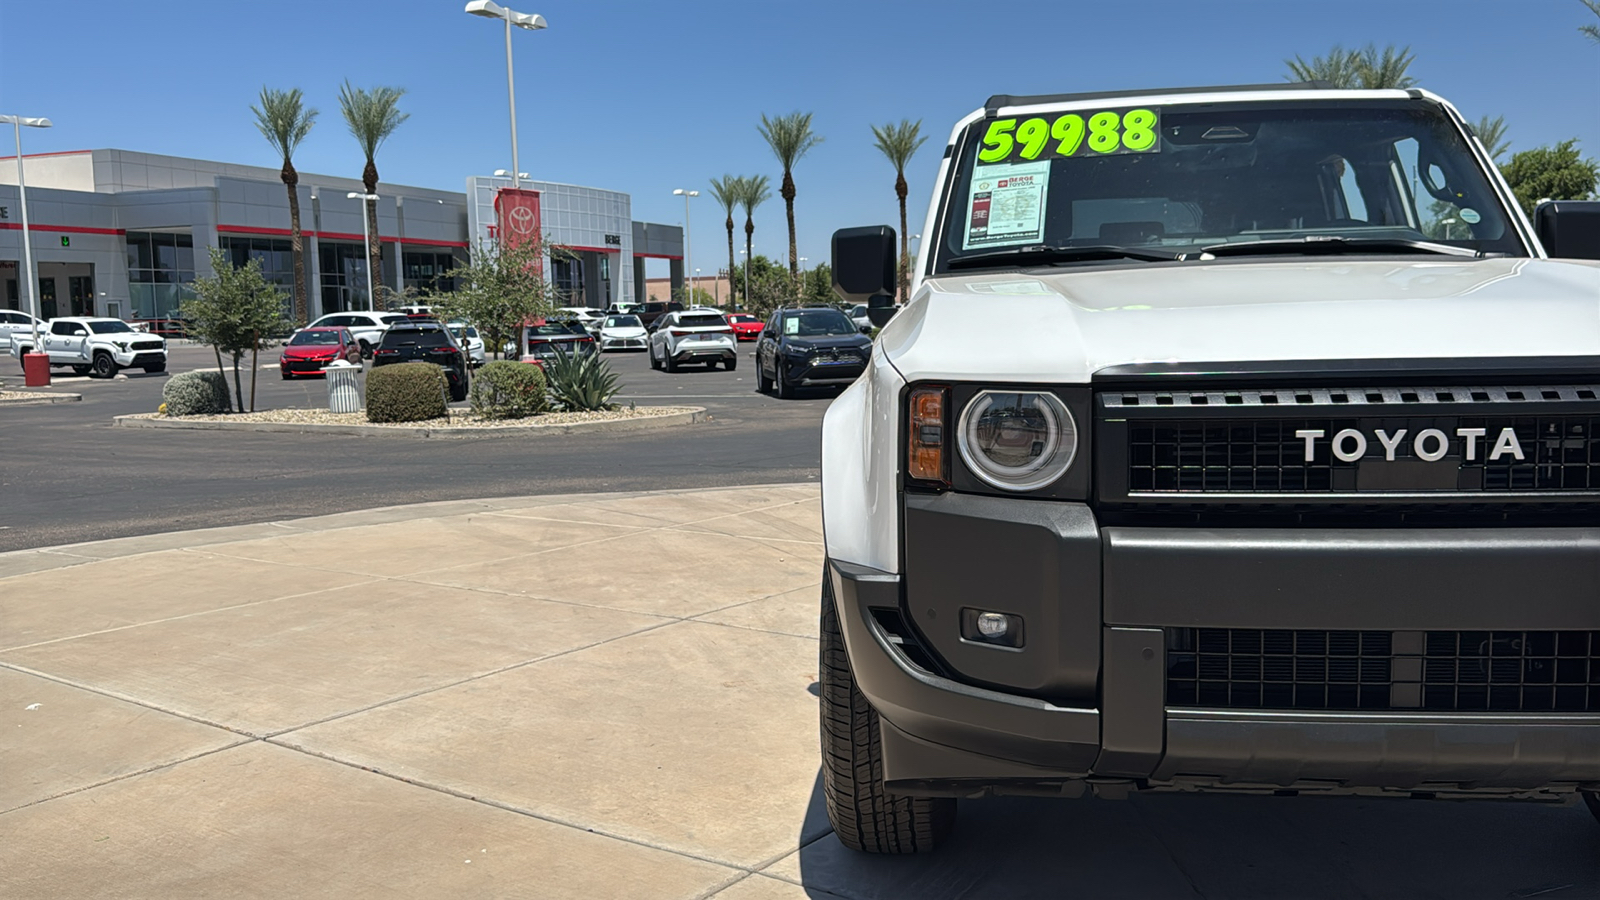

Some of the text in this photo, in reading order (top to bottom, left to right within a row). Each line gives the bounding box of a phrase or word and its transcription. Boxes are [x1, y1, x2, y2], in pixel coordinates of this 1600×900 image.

[978, 109, 1156, 162] 59988
[1009, 175, 1034, 183] BERGE
[605, 234, 621, 245] BERGE
[1295, 427, 1525, 463] TOYOTA
